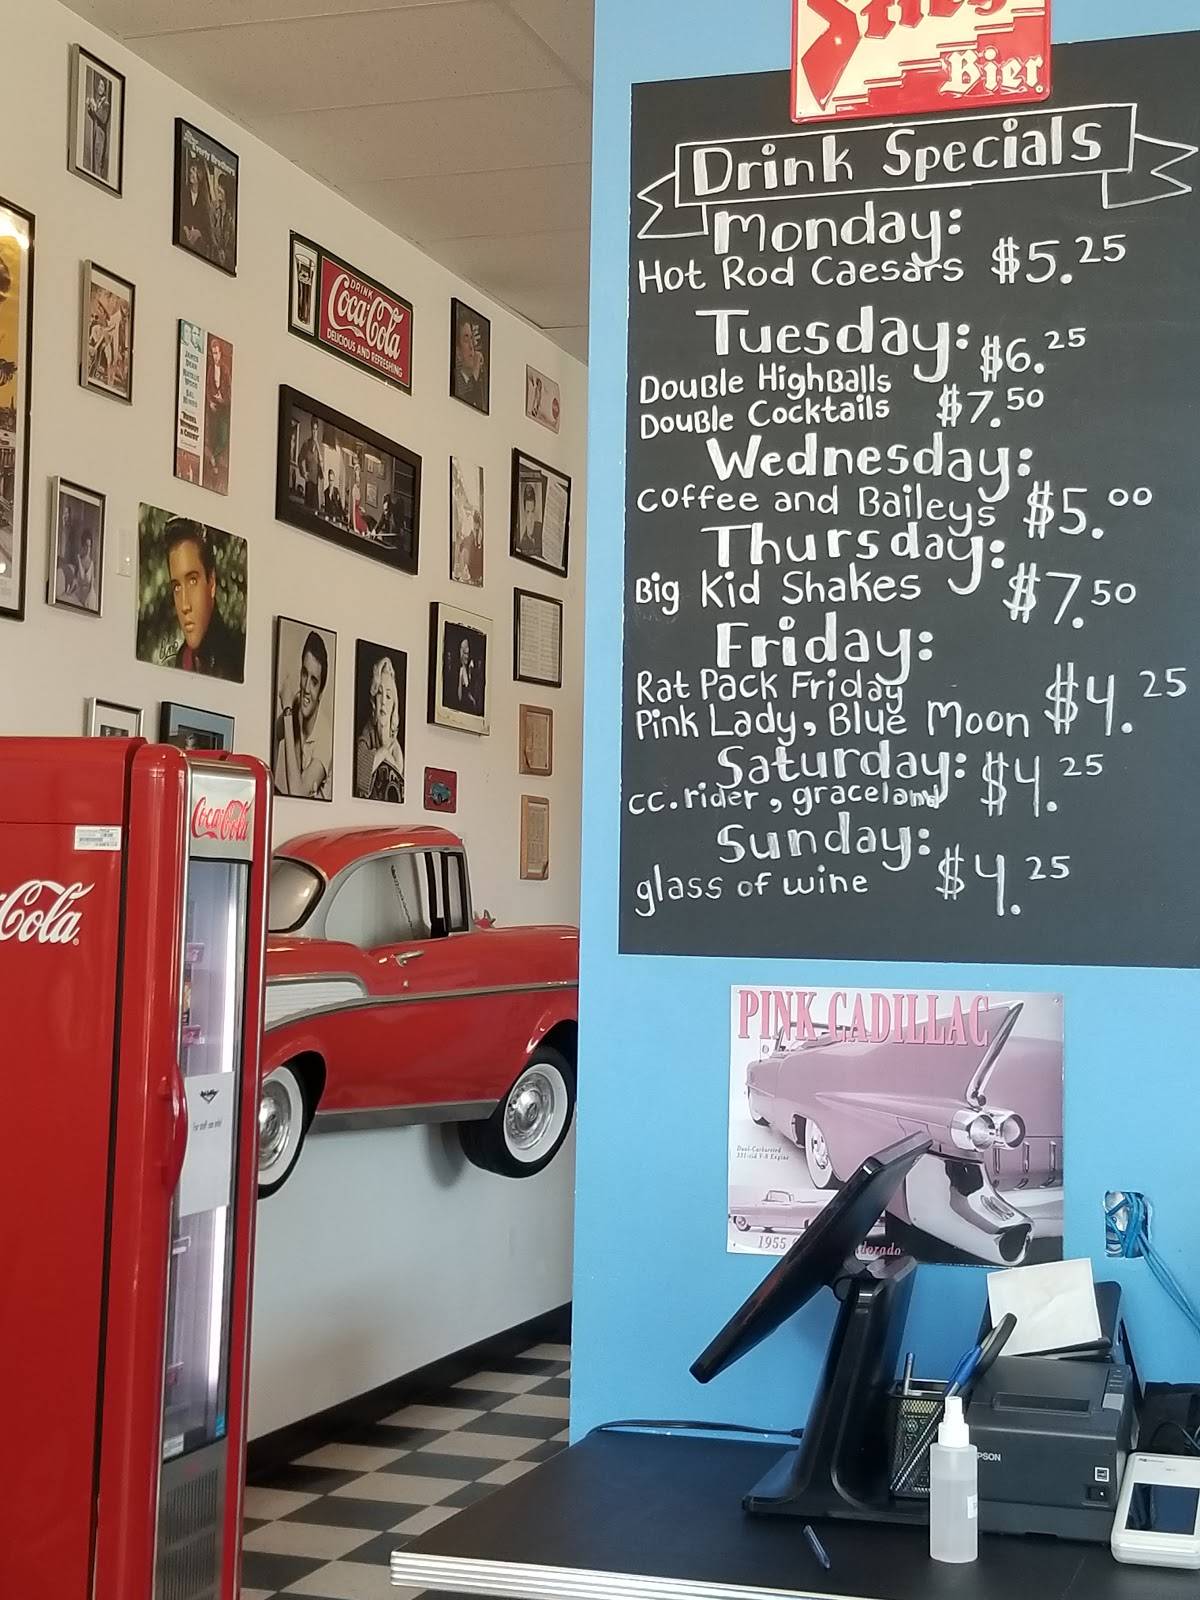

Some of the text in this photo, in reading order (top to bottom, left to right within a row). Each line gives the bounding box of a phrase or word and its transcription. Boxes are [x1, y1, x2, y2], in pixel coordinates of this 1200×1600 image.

[940, 47, 1044, 96] Bier
[692, 116, 1103, 197] Drink Specials
[714, 201, 963, 267] Monday:
[350, 279, 374, 299] DRINK
[638, 259, 706, 294] Hot
[722, 255, 795, 290] Rod
[811, 255, 965, 286] Caesars
[327, 328, 403, 378] DELICIOUS AND REFRESHING
[695, 304, 971, 384] Tuesday:
[747, 393, 891, 428] Cocktails
[706, 431, 1035, 503] Wednesday:
[773, 484, 839, 515] and
[858, 482, 997, 538] Baileys
[701, 521, 1007, 596] Thursday:
[635, 570, 681, 616] Big
[701, 568, 761, 610] Kid
[781, 561, 923, 606] Shakes
[716, 611, 935, 686] Friday:
[636, 668, 905, 716] Rat Pack Friday
[635, 703, 701, 741] Pink
[708, 702, 817, 746] Lady,
[828, 701, 909, 737] Blue
[927, 699, 1031, 739] Moon
[714, 739, 968, 802] Saturday:
[791, 781, 942, 817] graceland
[716, 810, 932, 872] Sunday:
[633, 863, 725, 918] glass
[736, 871, 773, 899] of
[782, 864, 870, 897] wine
[737, 989, 991, 1048] PINK CADILLAC
[759, 1235, 787, 1250] 1955
[859, 1241, 901, 1256] dorado
[976, 1451, 1002, 1462] PSON
